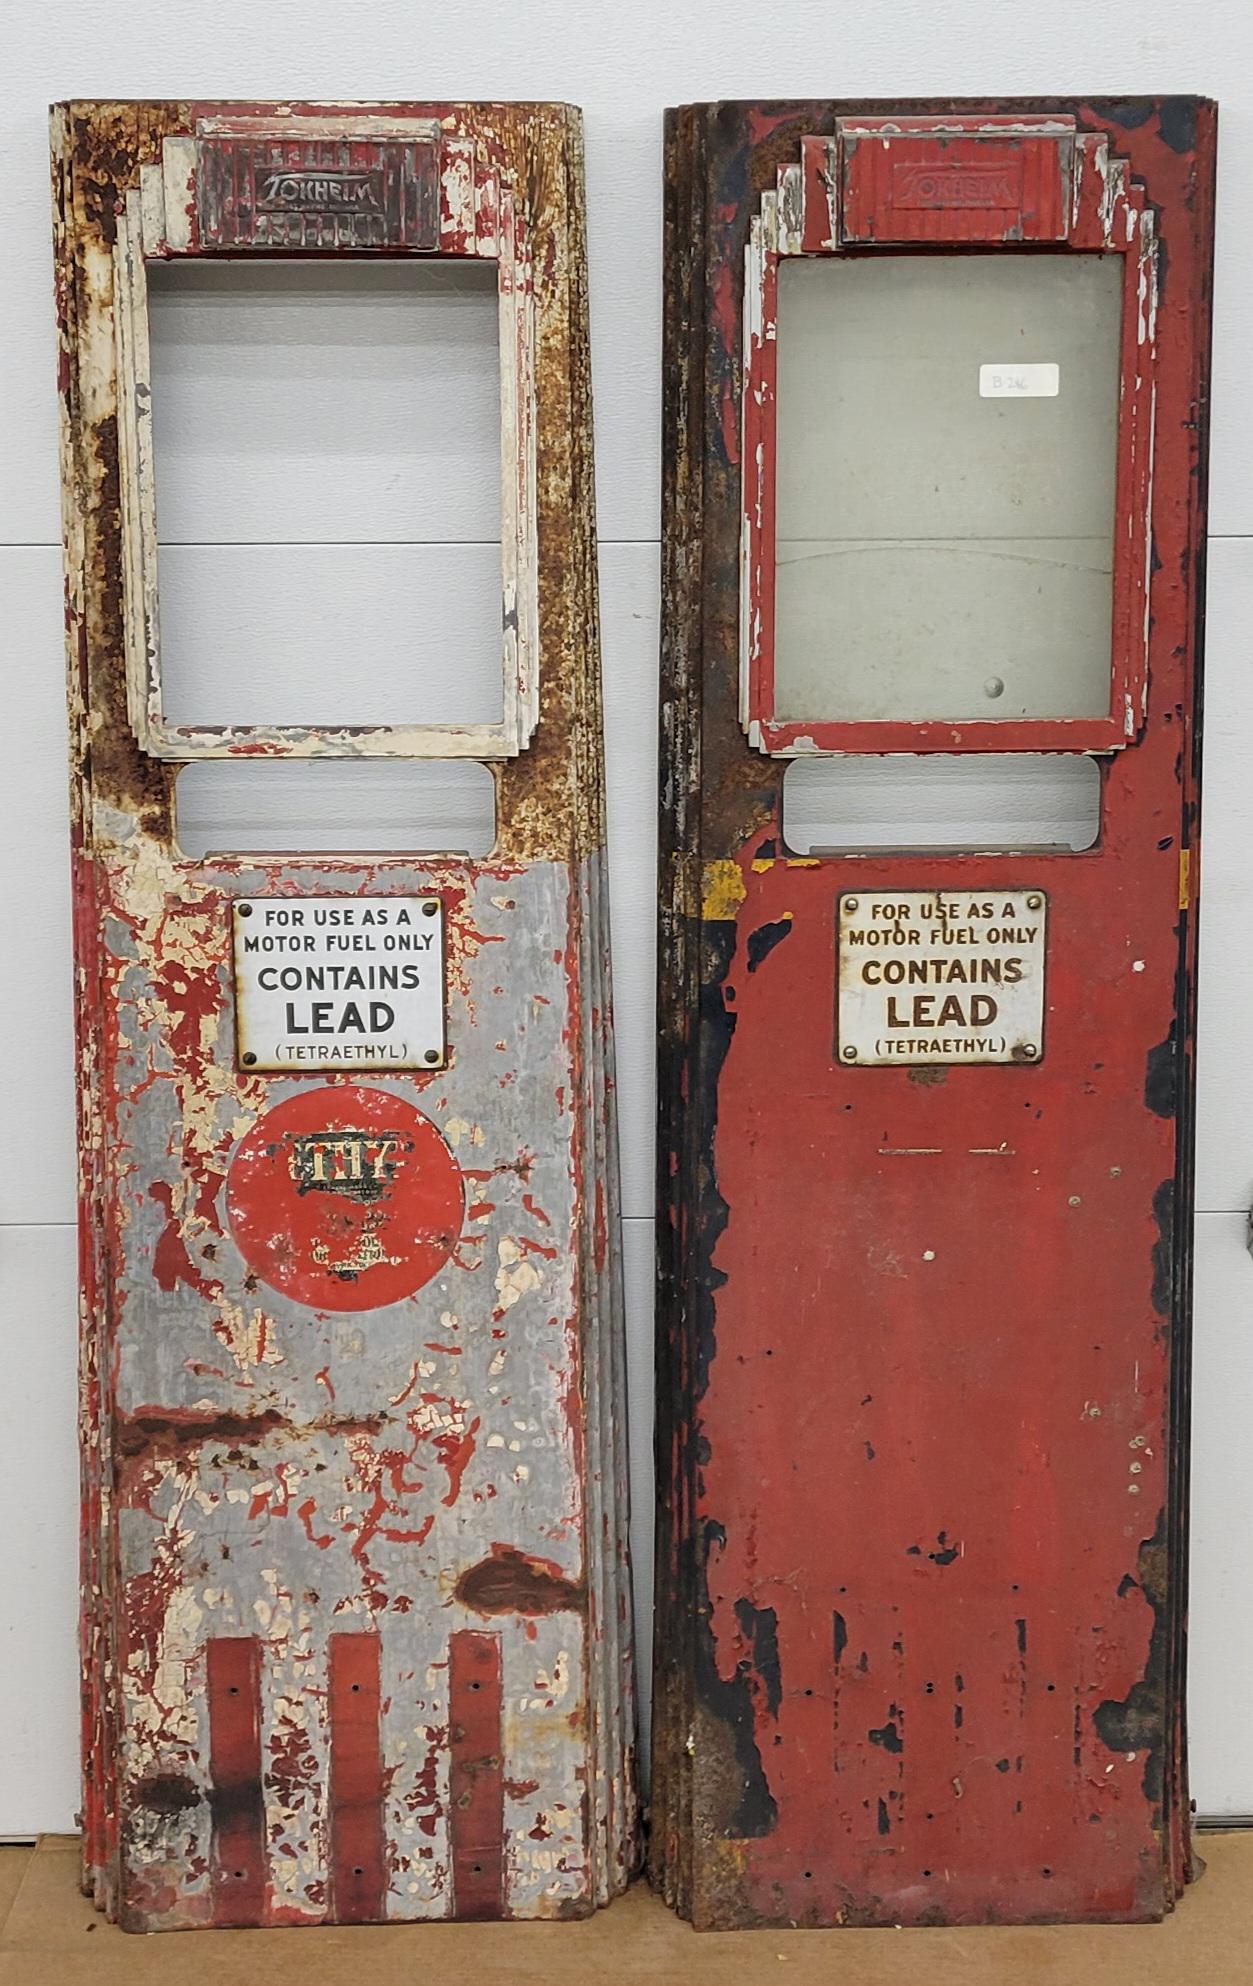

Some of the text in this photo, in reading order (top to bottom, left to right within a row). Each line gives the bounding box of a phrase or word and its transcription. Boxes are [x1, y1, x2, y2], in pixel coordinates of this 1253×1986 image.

[263, 172, 380, 207] TOKHEIM
[265, 908, 411, 926] FOR USE AS A
[871, 902, 1016, 920] FOR USE AS A
[244, 934, 434, 952] MOTOR FUEL ONLY
[849, 927, 1038, 946] MOTOR FUEL ONLY
[257, 965, 420, 991] CONTAINS
[862, 957, 1023, 985] CONTAINS
[286, 1001, 395, 1034] LEAD
[887, 994, 998, 1028] LEAD
[275, 1044, 408, 1061] (TETRAETHYL)
[875, 1037, 1006, 1056] (TETRAETHYL)
